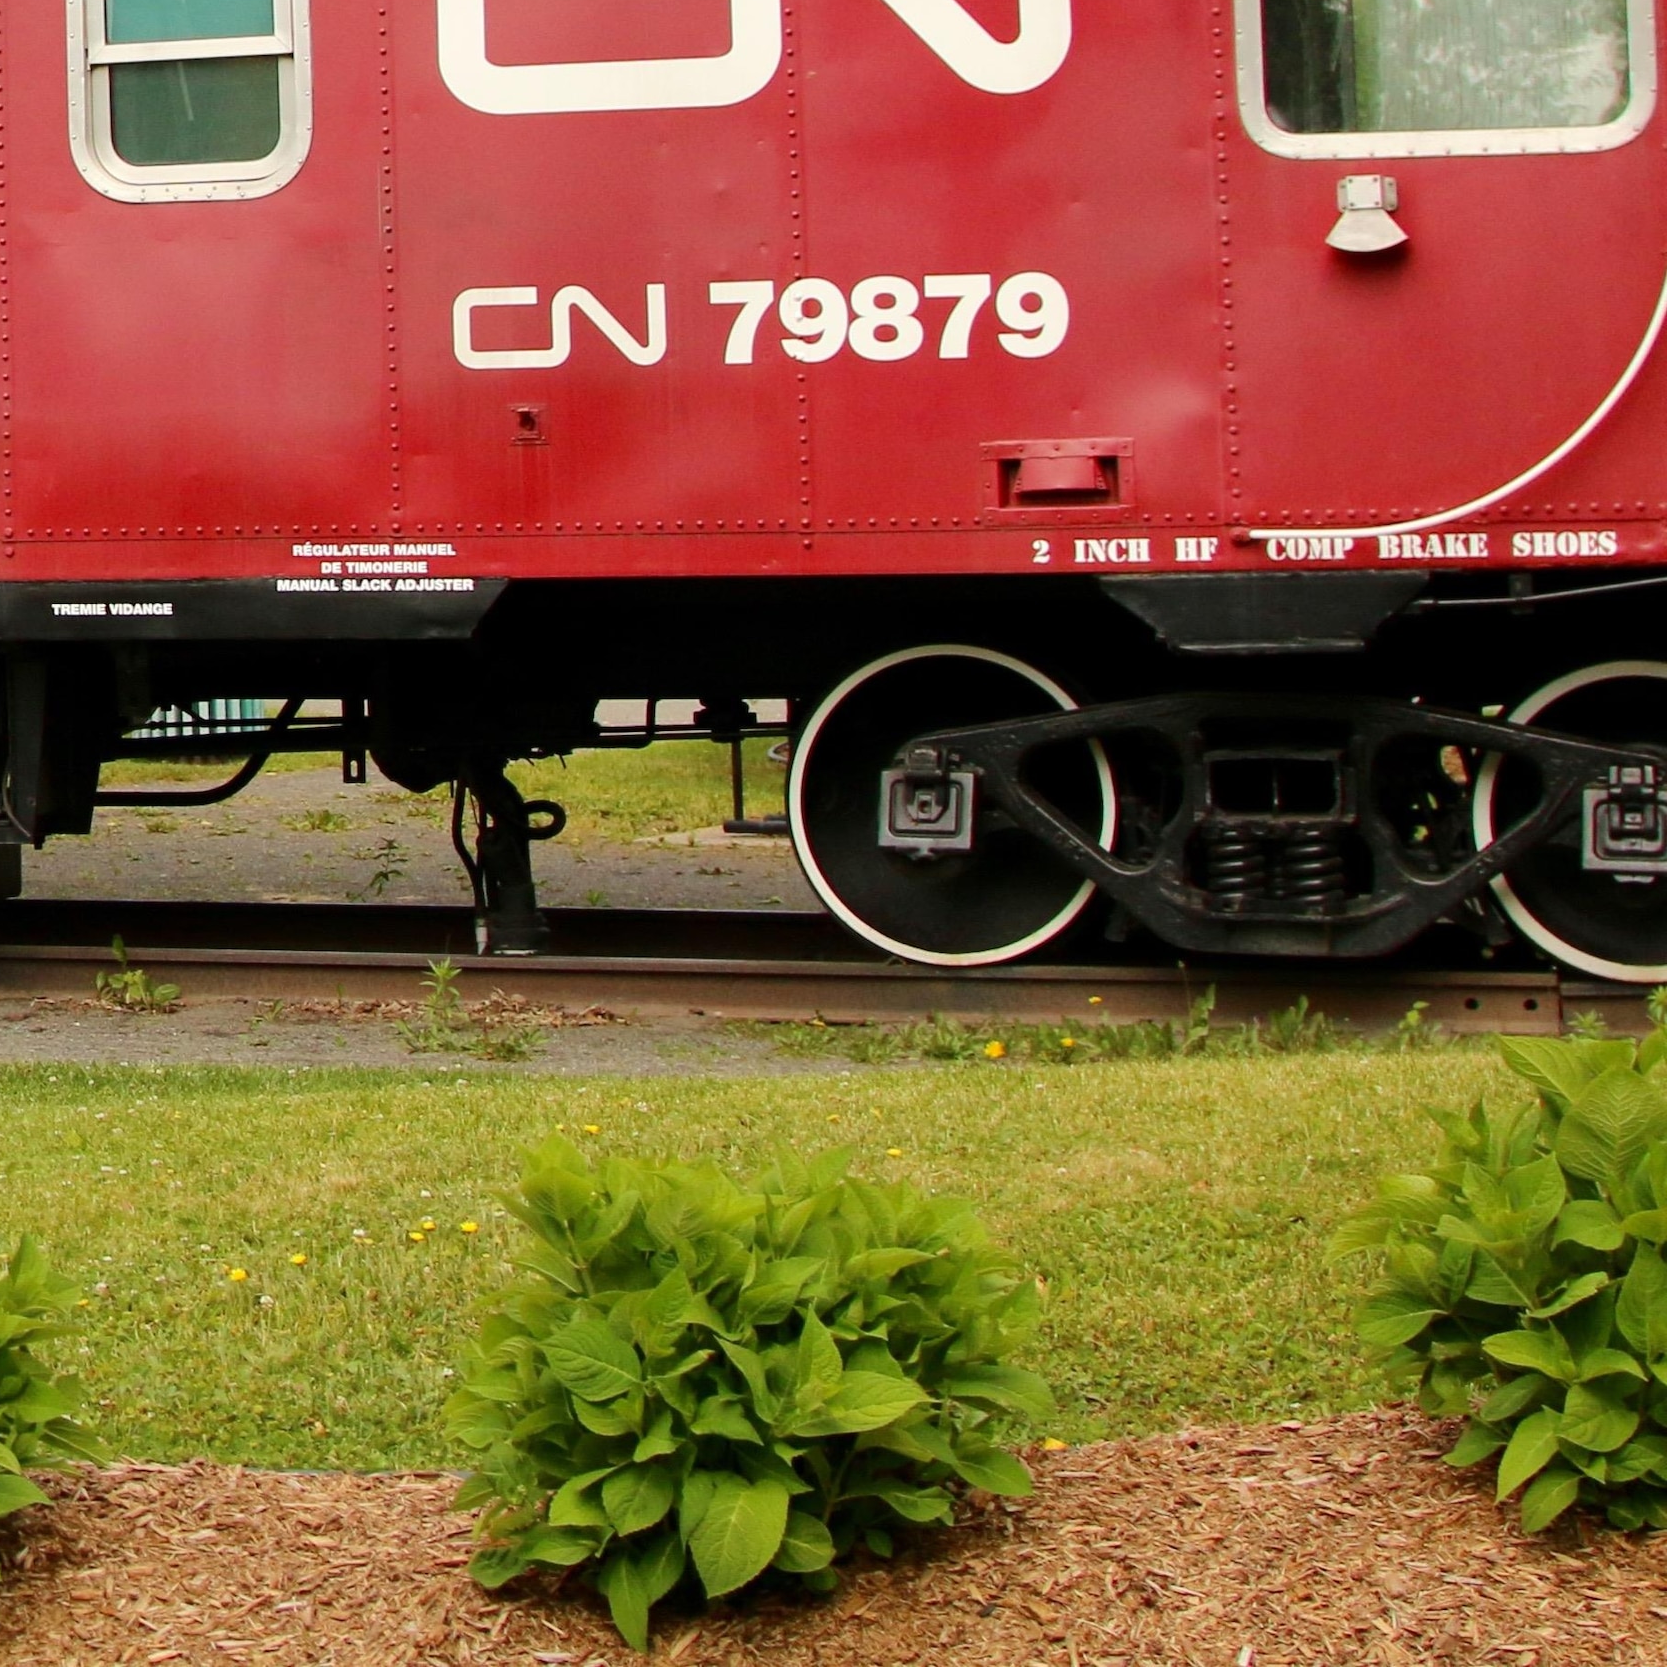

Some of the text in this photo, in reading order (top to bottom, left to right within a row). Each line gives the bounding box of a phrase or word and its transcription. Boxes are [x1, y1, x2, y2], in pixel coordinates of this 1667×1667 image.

[452, 271, 1069, 369] CN 79879
[292, 542, 457, 557] RÉGULATEUR MANUEL
[1032, 532, 1618, 565] 2 INCH HF COMP BRAKE SHOES
[320, 561, 428, 574] DE TIMONERIE
[276, 578, 474, 592] MANUAL SLACK ADJUSTER
[51, 603, 173, 616] TREMIE VIDANGE
